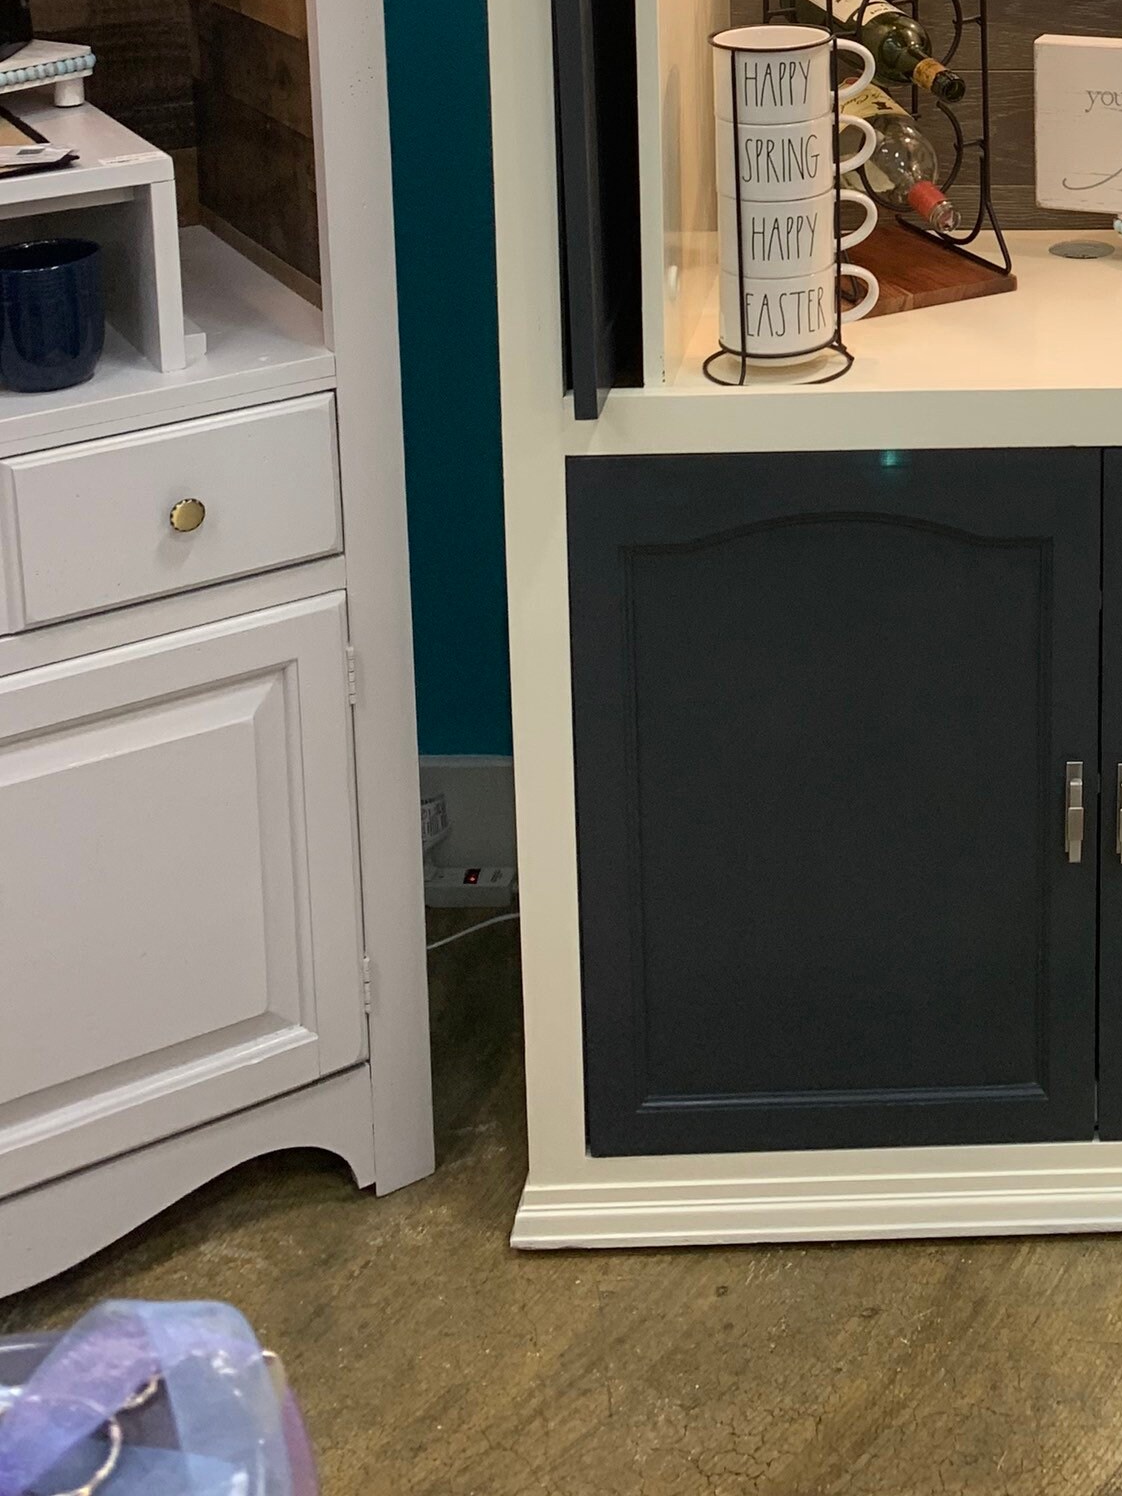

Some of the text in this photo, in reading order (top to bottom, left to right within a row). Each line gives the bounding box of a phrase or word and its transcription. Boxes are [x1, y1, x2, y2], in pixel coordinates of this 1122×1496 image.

[744, 59, 812, 107] HAPPY
[741, 134, 820, 184] SPRING
[751, 212, 818, 262] HAPPY
[745, 286, 827, 338] EASTER
